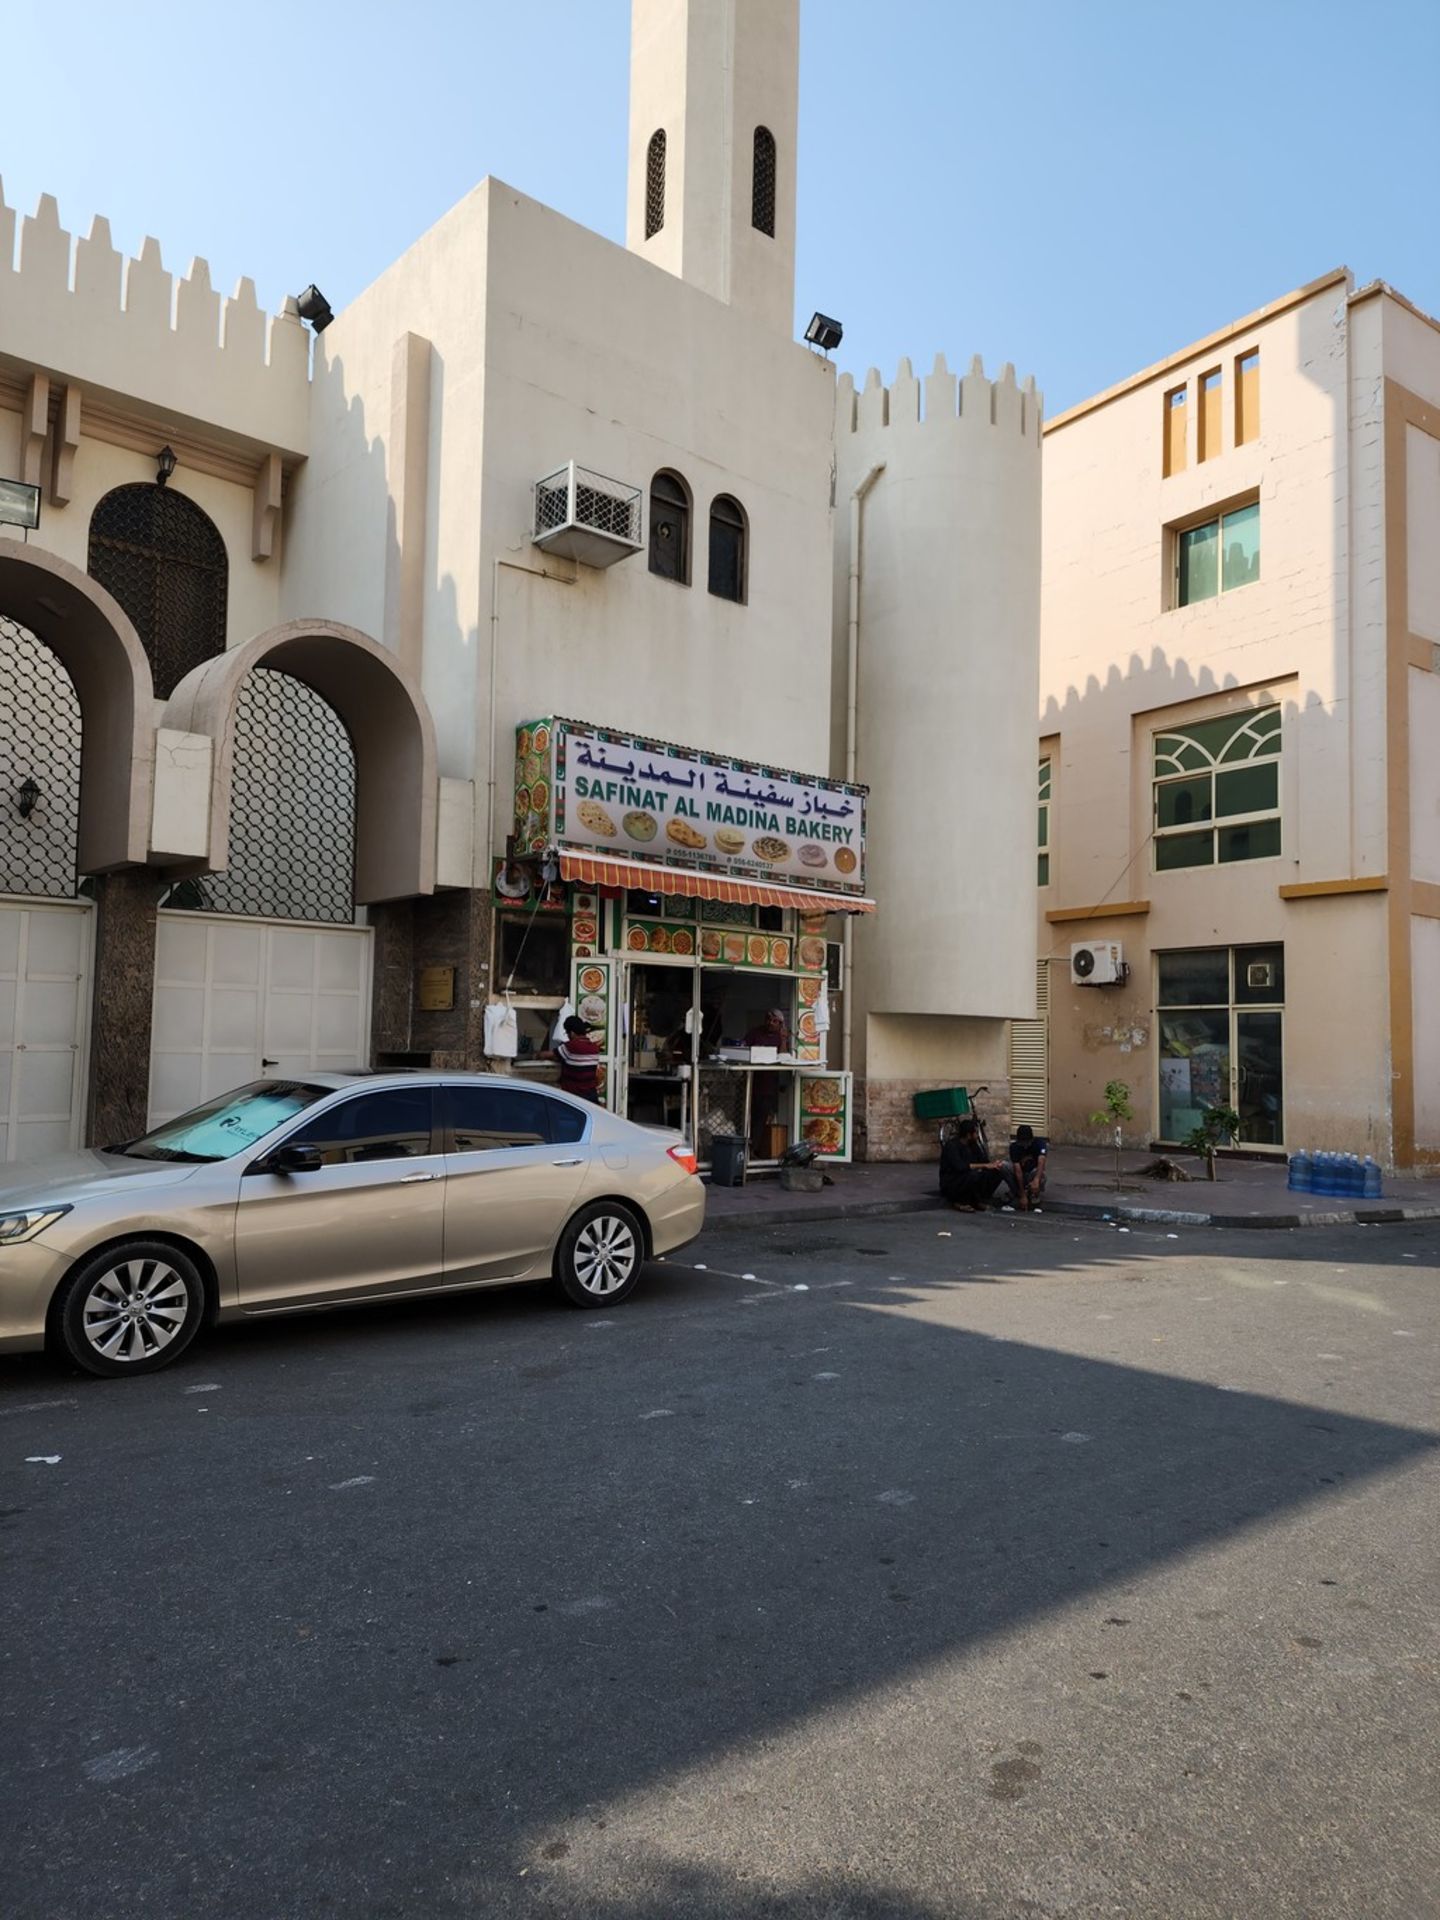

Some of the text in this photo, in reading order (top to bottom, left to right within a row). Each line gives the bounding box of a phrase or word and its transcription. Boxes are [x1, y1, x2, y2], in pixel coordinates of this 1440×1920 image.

[574, 740, 855, 820] خباز سفينة المدينة
[574, 775, 854, 846] SAFINAT AL MADINA BAKERY
